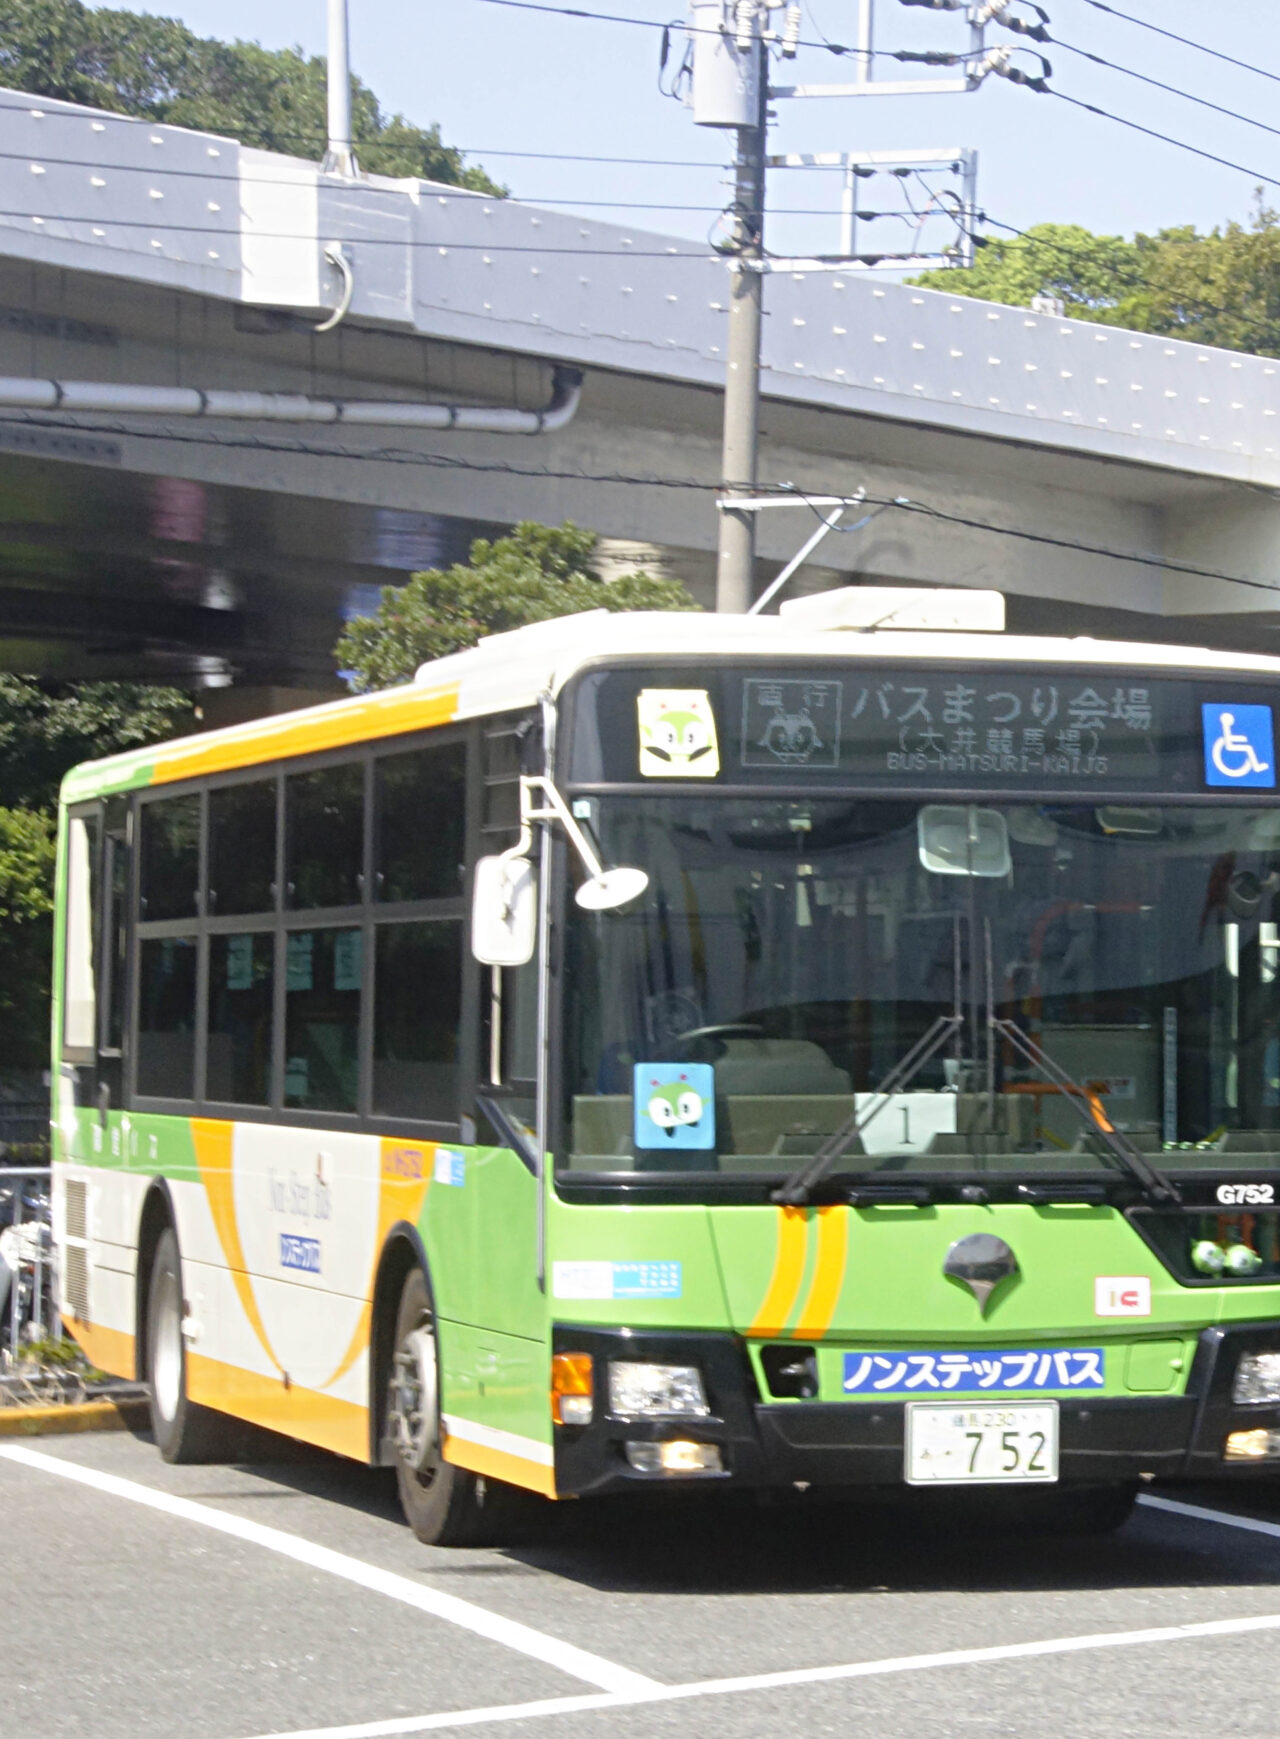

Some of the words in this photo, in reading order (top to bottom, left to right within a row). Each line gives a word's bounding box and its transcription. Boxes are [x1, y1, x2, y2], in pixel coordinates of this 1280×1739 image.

[850, 681, 1152, 731] バスまつり会場
[896, 1103, 917, 1146] 1
[1215, 1184, 1275, 1205] G752
[843, 1350, 1104, 1392] ノンステップバス
